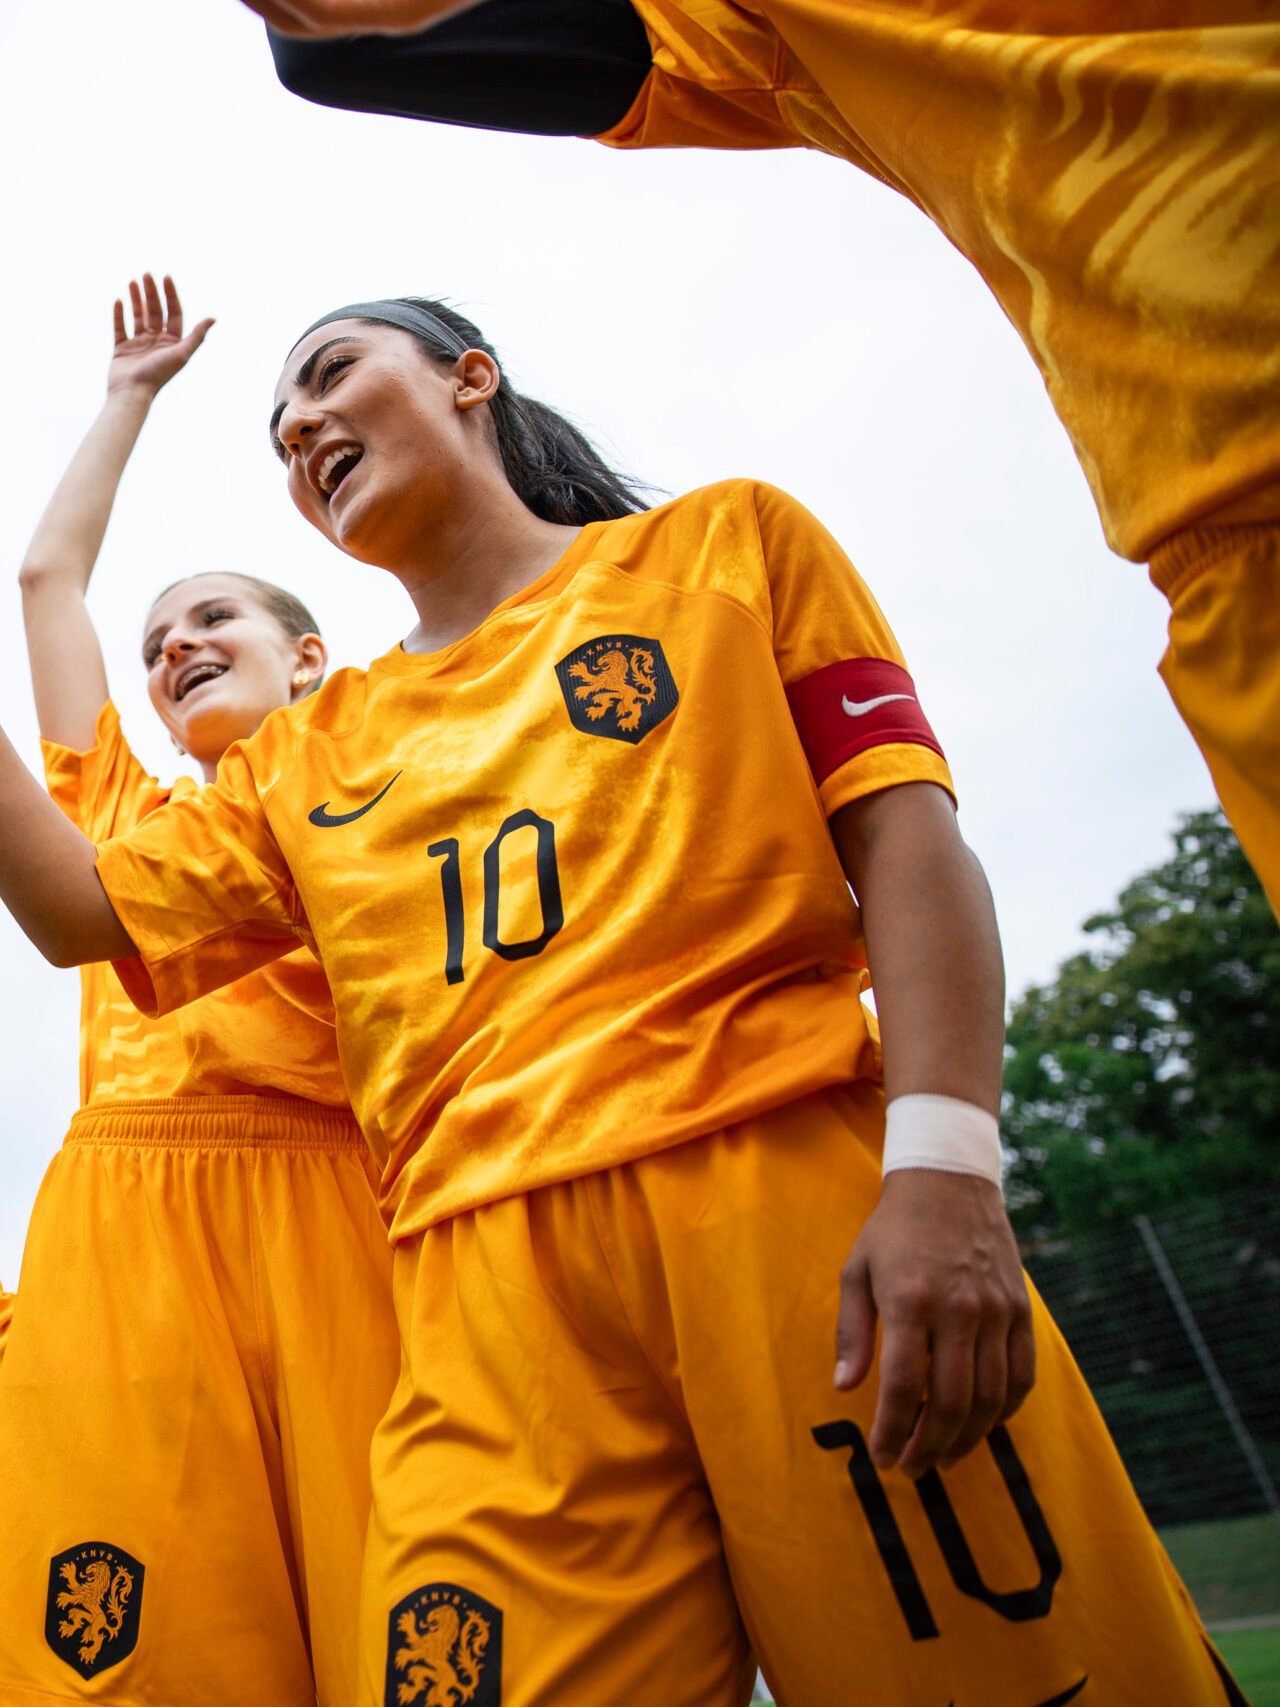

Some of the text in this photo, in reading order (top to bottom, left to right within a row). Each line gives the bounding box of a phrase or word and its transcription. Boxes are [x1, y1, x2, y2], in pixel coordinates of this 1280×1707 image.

[427, 808, 564, 986] 10
[81, 1549, 113, 1561] KNVB
[810, 1419, 1063, 1642] 10
